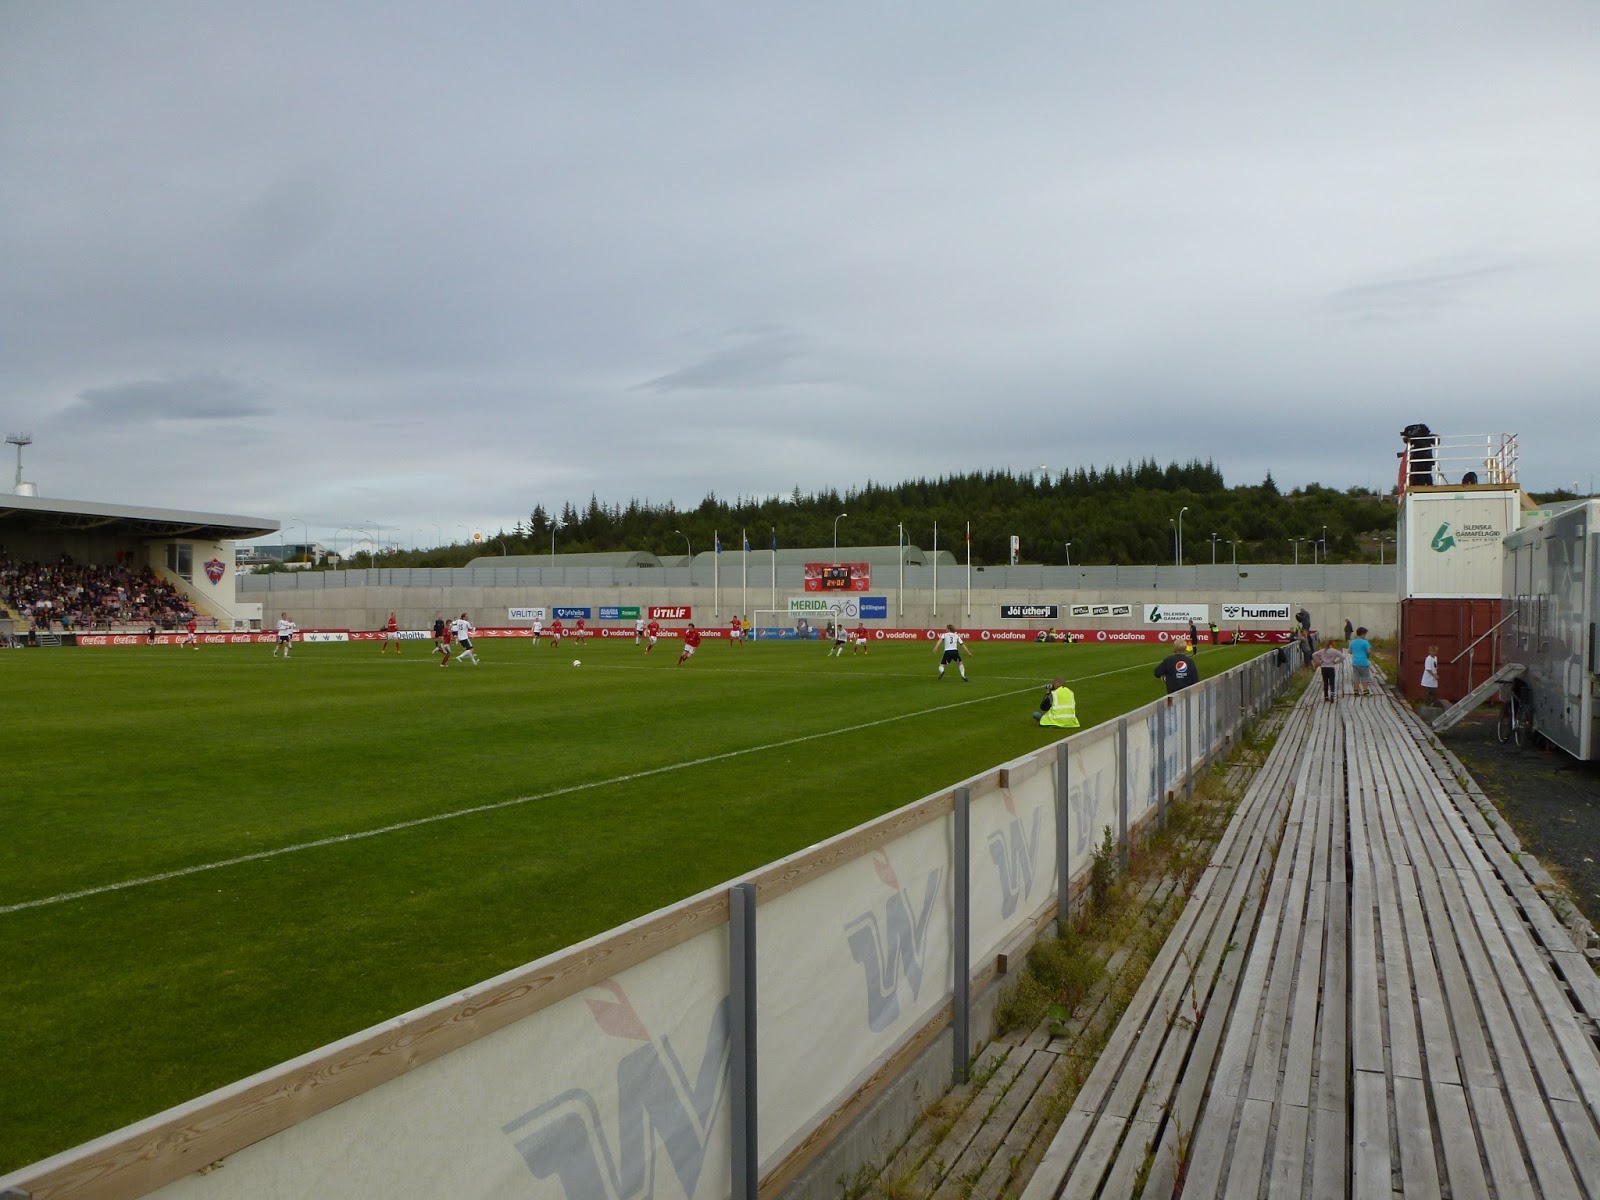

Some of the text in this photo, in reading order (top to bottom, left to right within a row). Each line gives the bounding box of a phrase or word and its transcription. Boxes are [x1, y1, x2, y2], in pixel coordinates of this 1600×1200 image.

[791, 600, 827, 610] MERIDA
[653, 607, 686, 618] ÚTILÍF
[1241, 606, 1289, 618] hummel
[885, 631, 917, 639] vodafone
[992, 632, 1026, 640] vodafone
[1108, 632, 1146, 640] vodafone
[949, 636, 954, 644] 3
